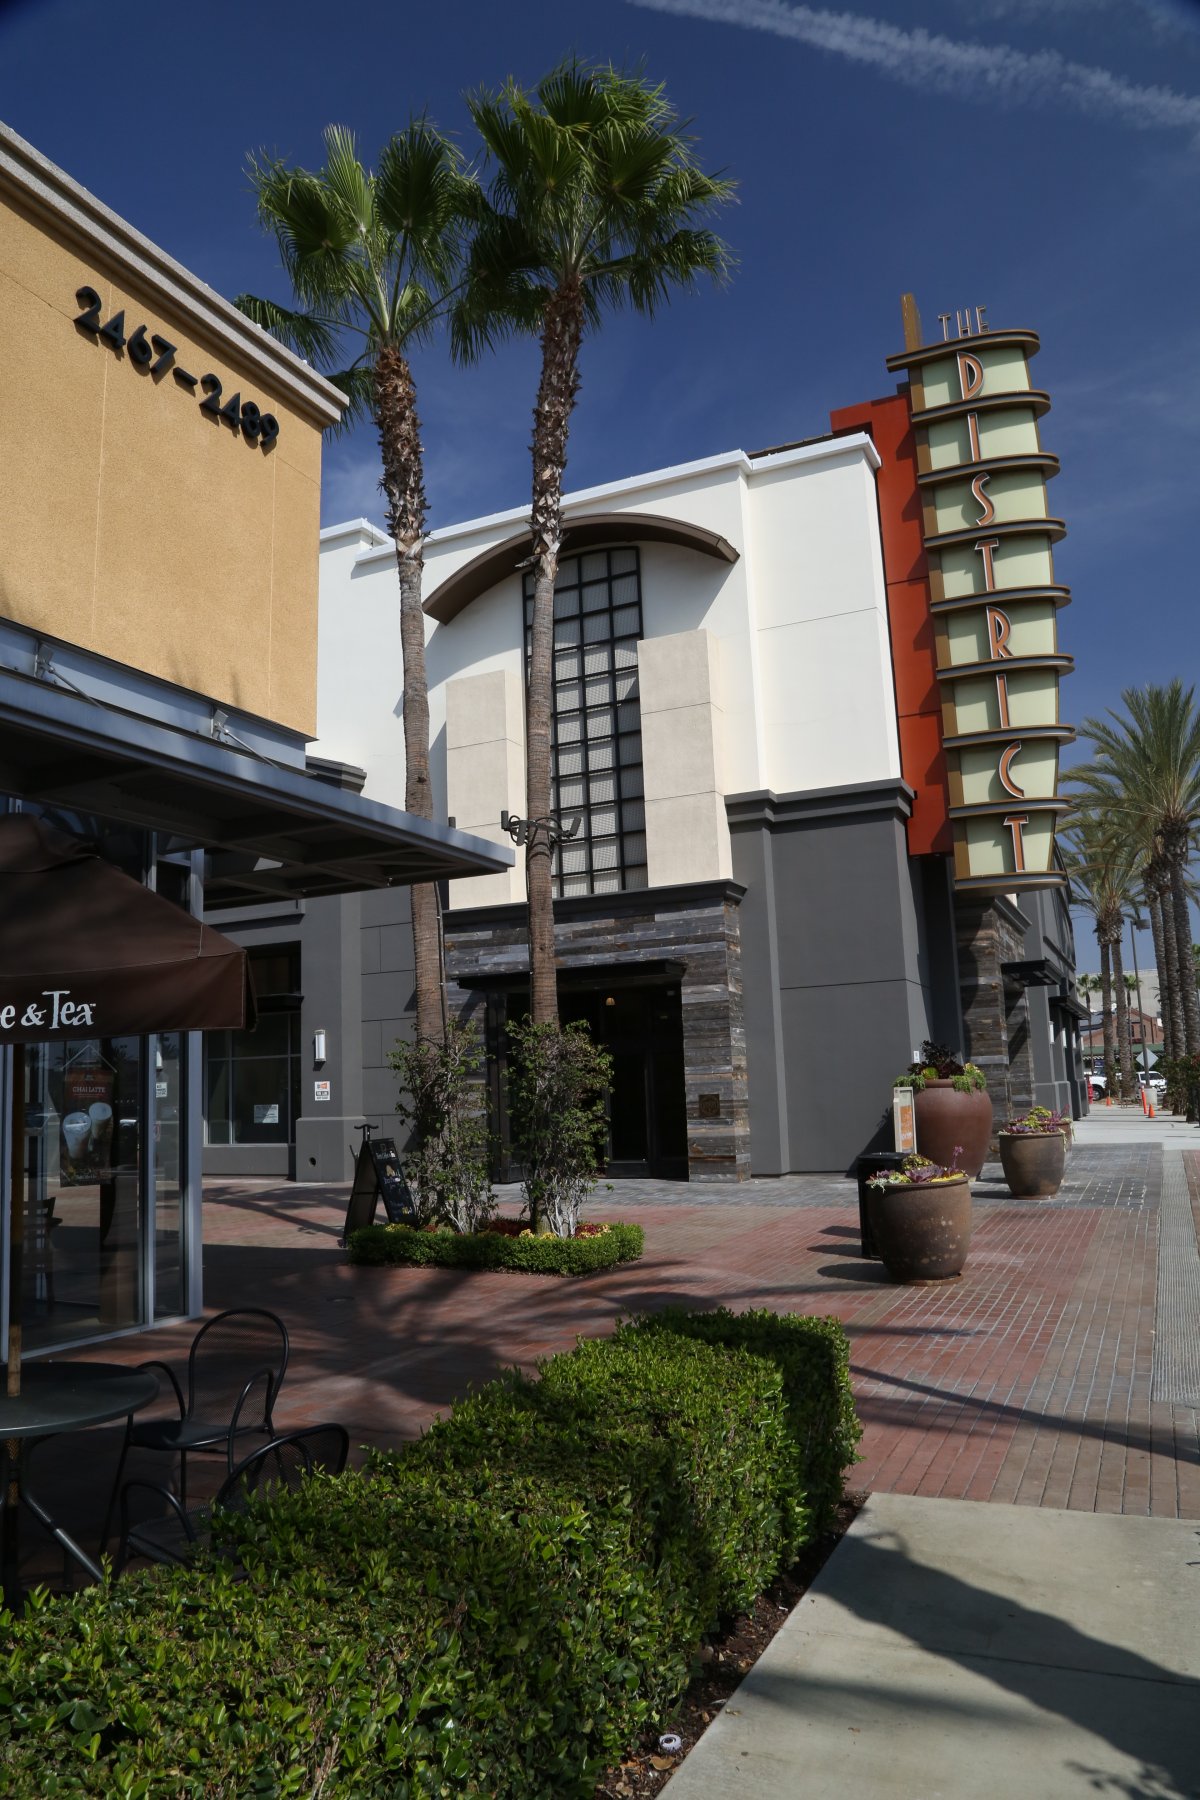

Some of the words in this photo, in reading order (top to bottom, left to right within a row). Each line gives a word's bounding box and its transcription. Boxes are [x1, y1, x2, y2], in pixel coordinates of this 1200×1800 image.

[937, 305, 990, 342] THE
[72, 285, 280, 448] 2467-2489
[957, 351, 1029, 873] DISTRICT
[20, 1003, 47, 1026] &
[88, 1085, 106, 1093] LATTE
